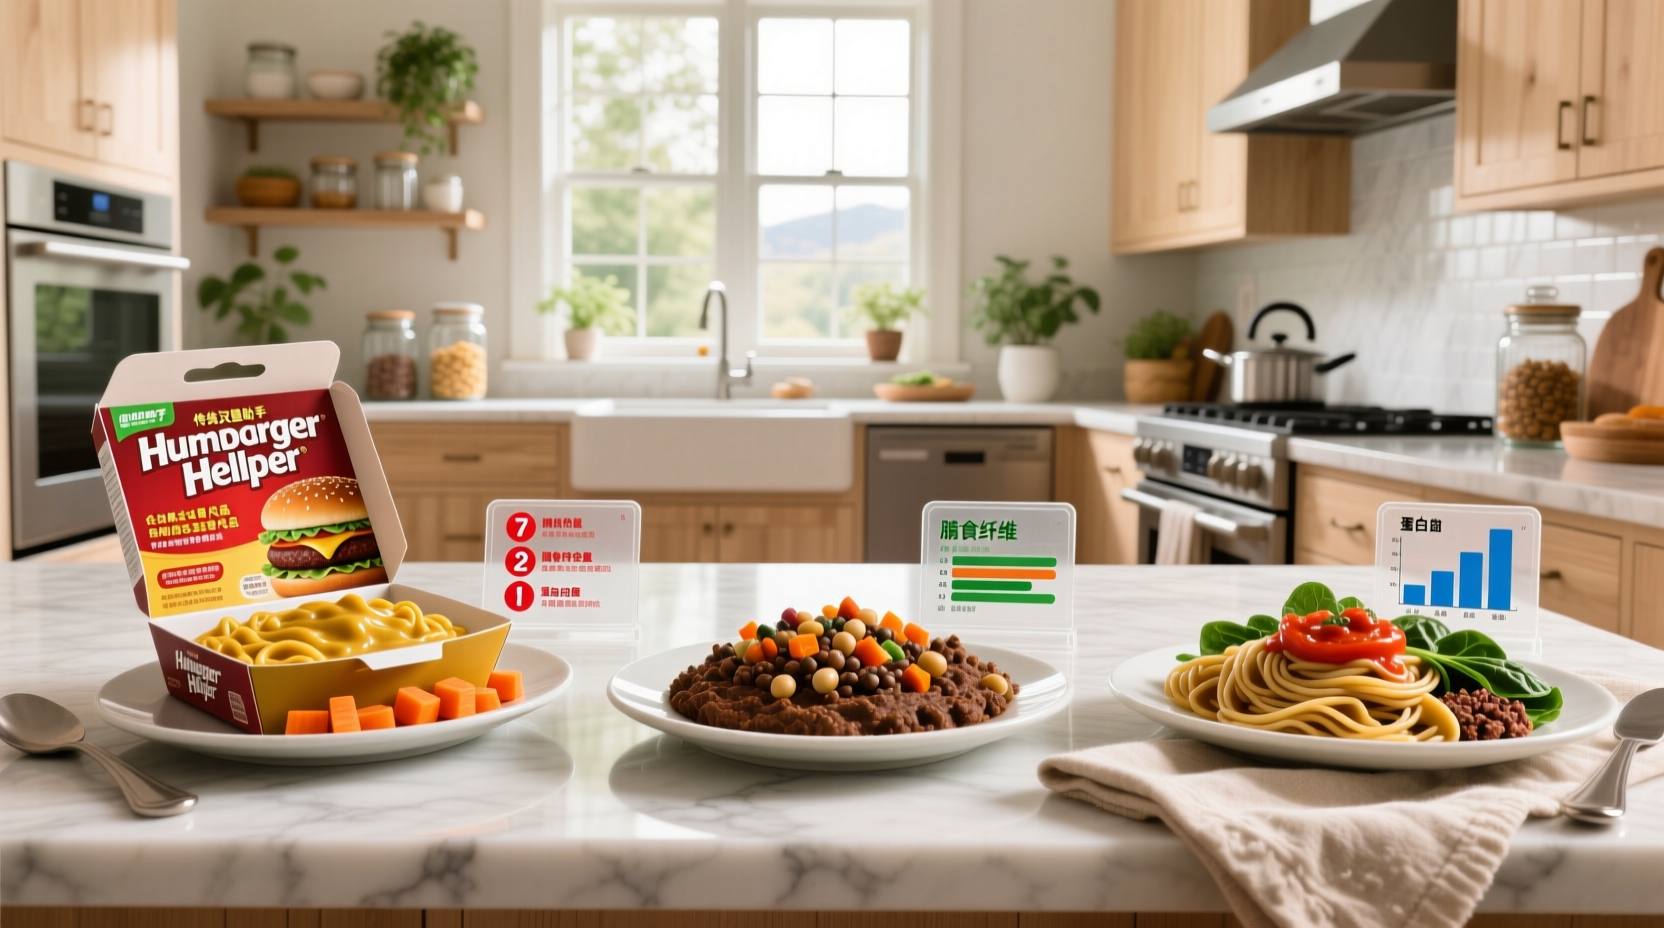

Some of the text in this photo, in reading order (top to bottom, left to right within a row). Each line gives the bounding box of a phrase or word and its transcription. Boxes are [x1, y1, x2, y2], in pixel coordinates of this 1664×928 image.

[182, 448, 300, 497] Hellper
[515, 517, 529, 537] 7
[513, 551, 529, 572] 2
